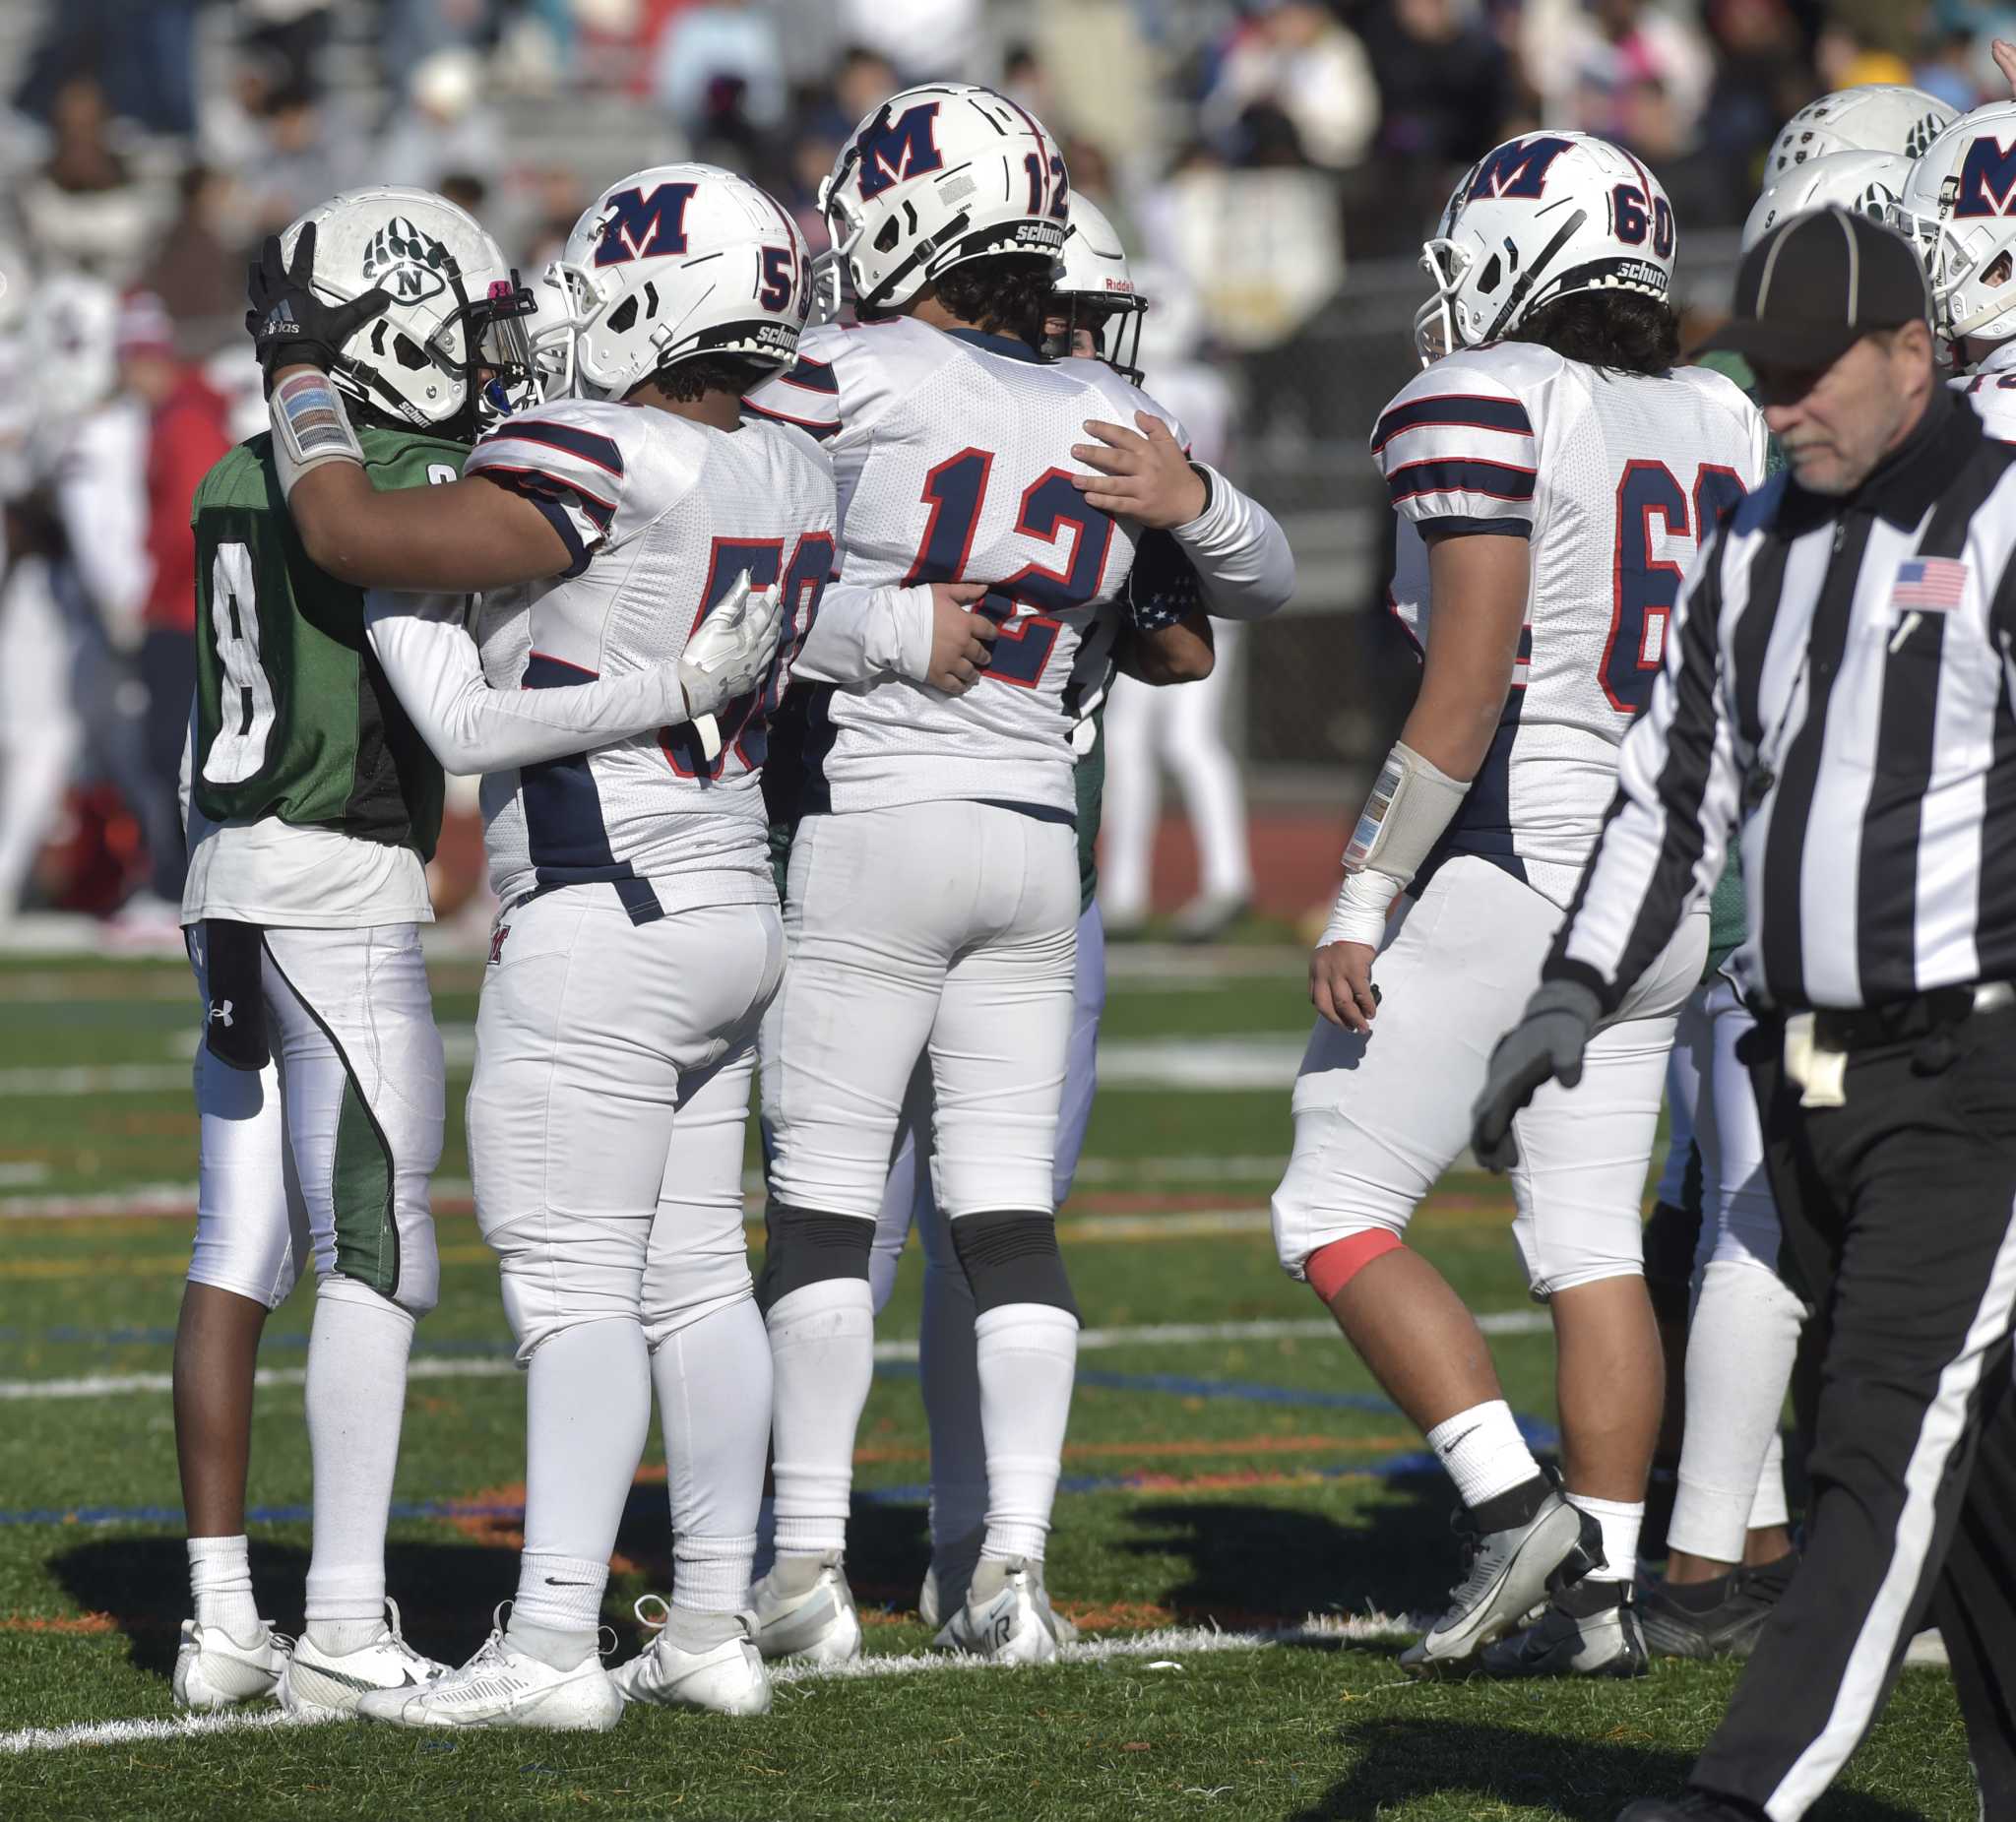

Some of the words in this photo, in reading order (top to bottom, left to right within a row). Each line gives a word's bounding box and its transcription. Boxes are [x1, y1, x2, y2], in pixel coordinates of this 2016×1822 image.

[856, 101, 945, 203] M
[1024, 153, 1070, 220] 12
[1465, 137, 1577, 205] M
[594, 182, 699, 269] M
[1611, 183, 1673, 261] 60
[396, 269, 423, 296] N
[900, 446, 1115, 689] 12
[203, 542, 276, 784] 8
